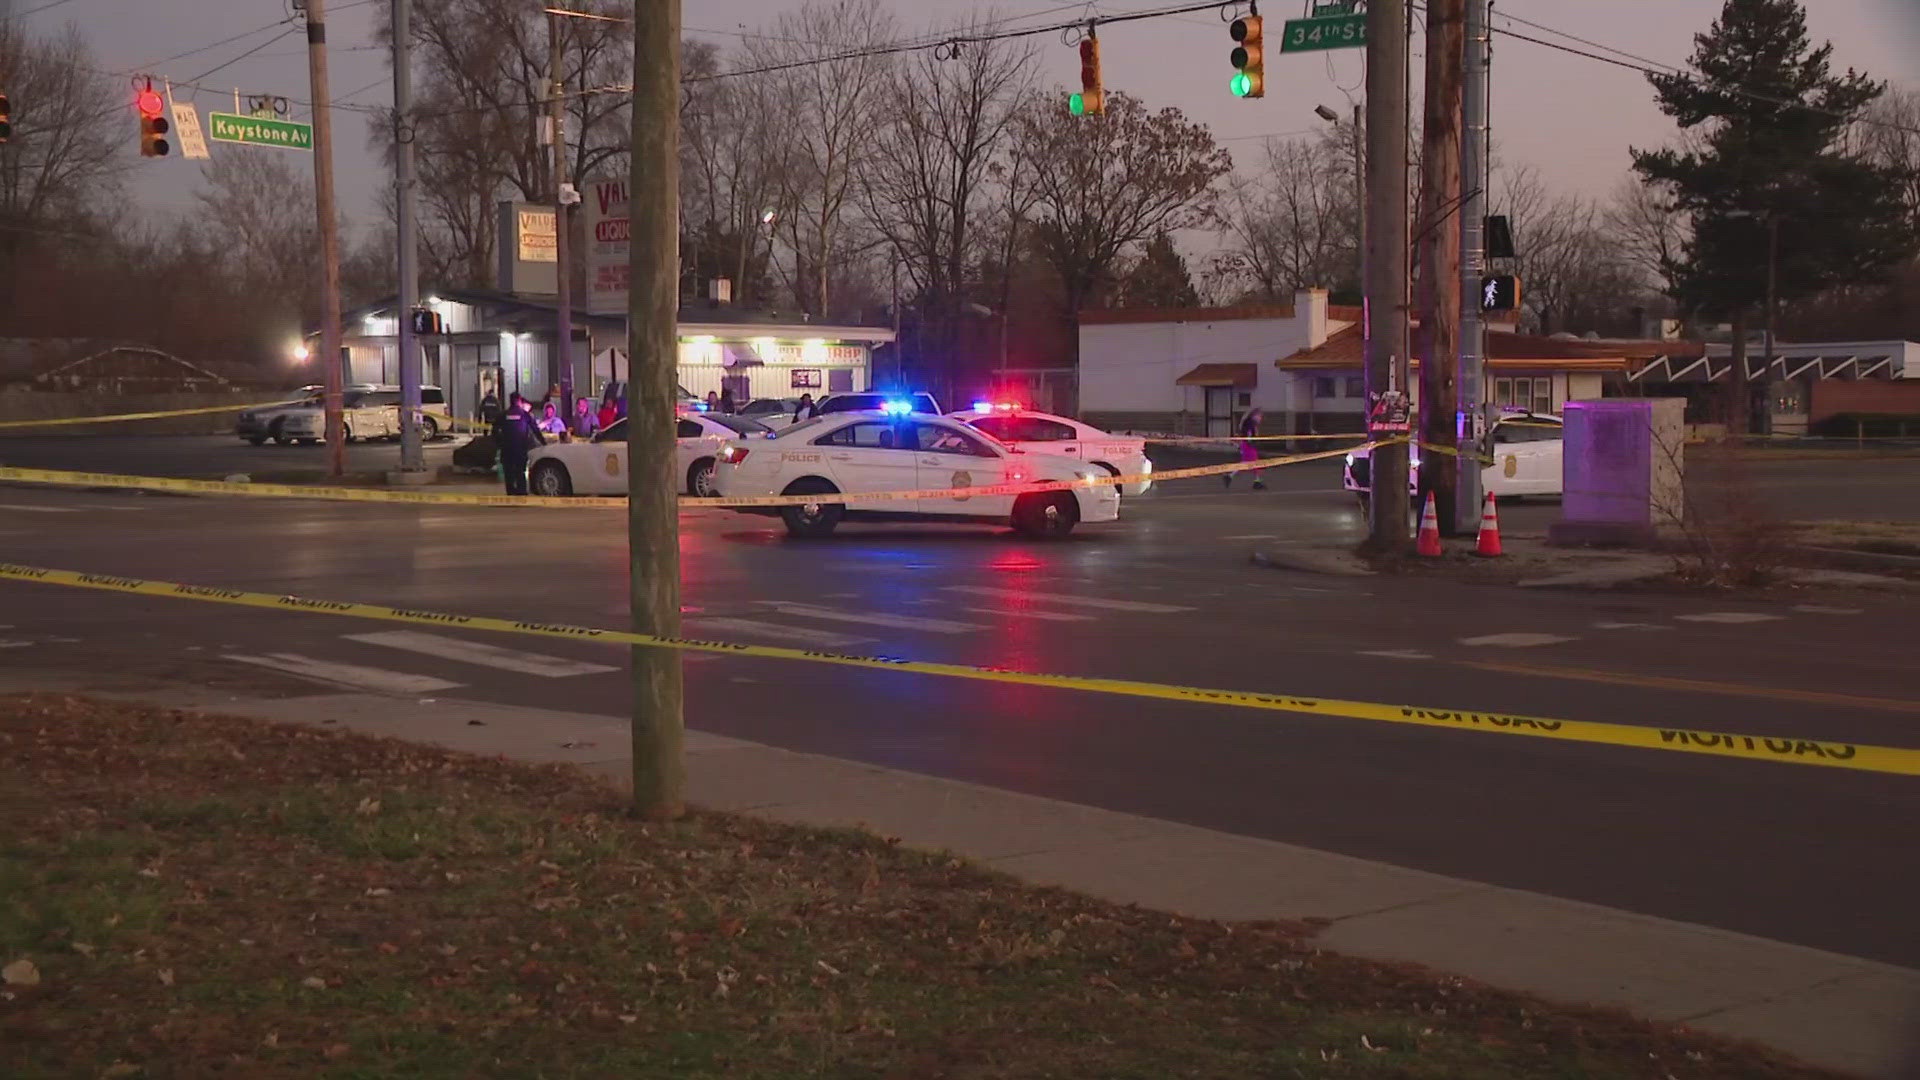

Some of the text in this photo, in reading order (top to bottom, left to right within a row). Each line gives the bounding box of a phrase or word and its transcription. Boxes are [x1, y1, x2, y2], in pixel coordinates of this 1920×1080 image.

[1292, 23, 1367, 45] 34th St
[216, 120, 288, 141] Keystone
[291, 127, 309, 144] Av
[597, 182, 628, 215] VAL
[600, 222, 630, 240] LIQU
[781, 452, 820, 463] POLICE
